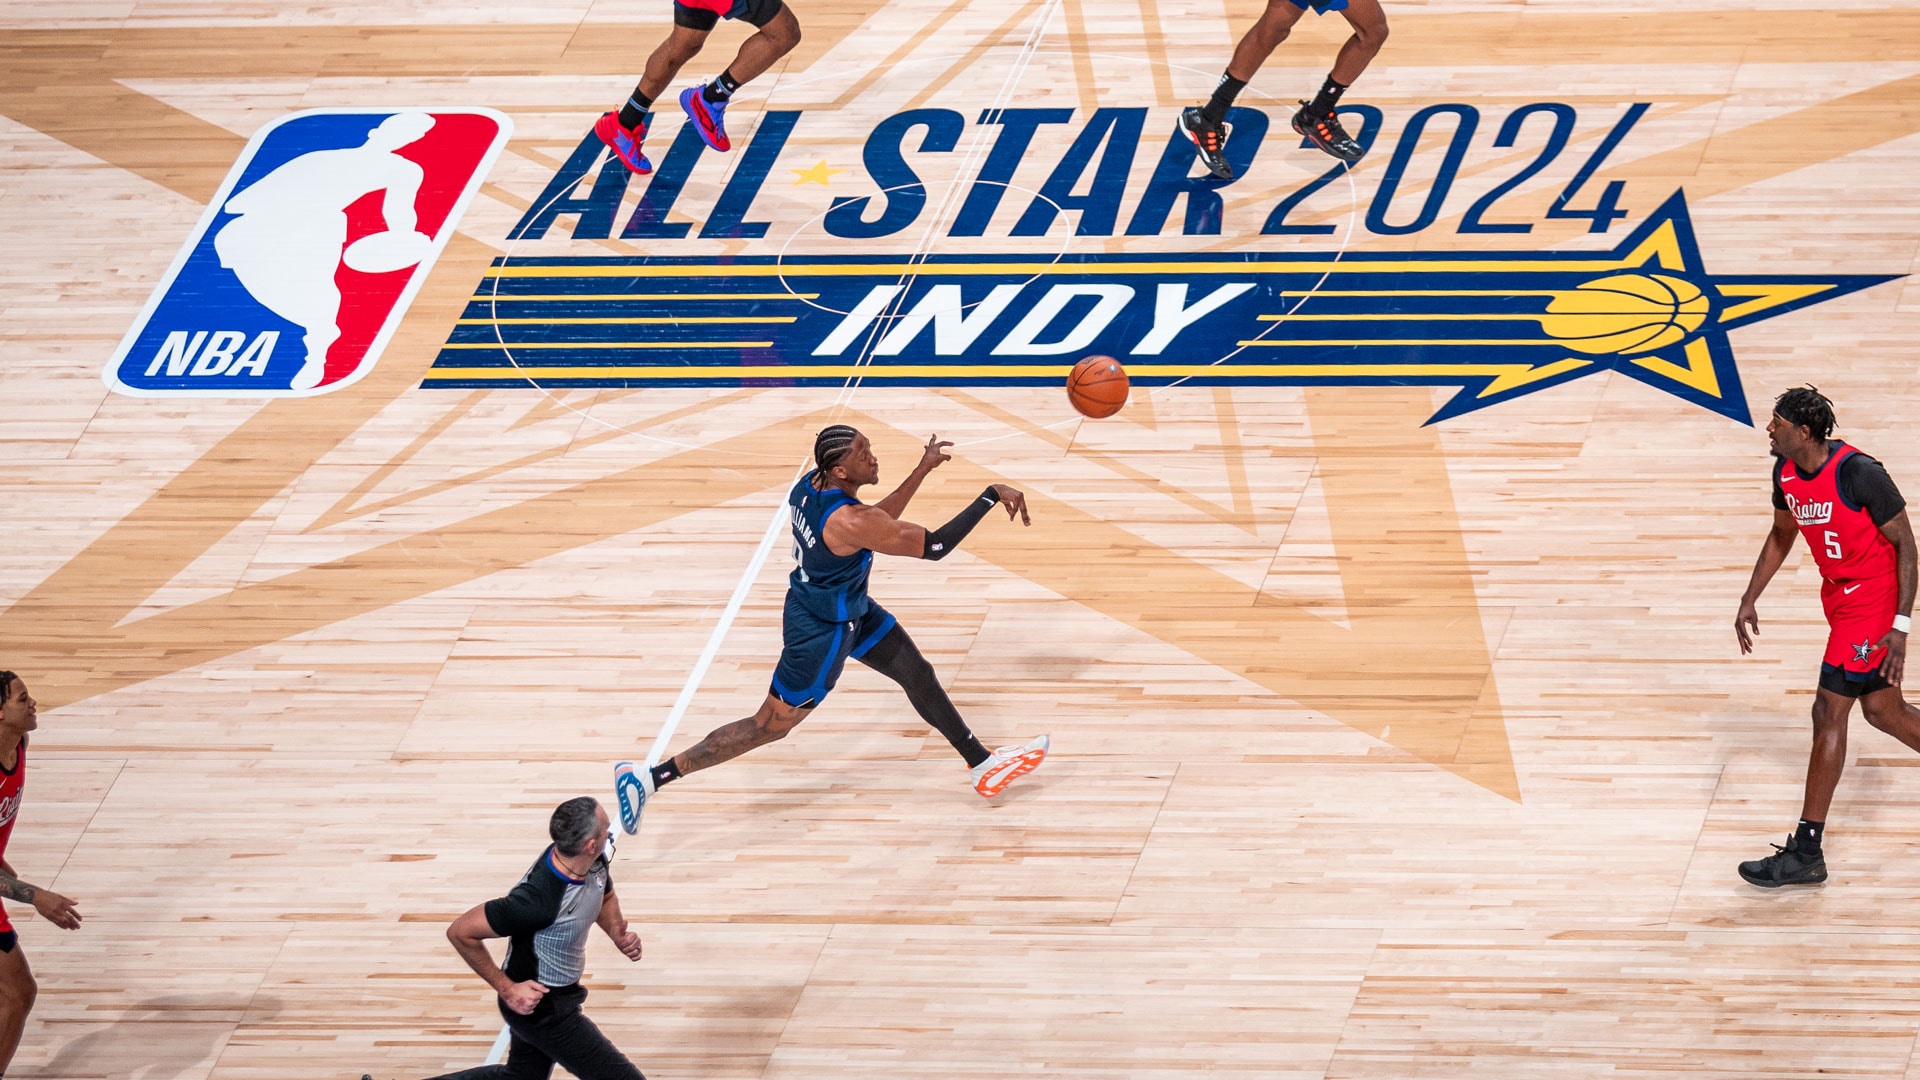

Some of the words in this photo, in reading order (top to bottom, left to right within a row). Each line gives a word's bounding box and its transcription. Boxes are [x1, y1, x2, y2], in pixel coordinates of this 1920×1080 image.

[506, 110, 803, 240] ALL
[823, 108, 1270, 239] STAR
[1260, 102, 1653, 235] 2024
[811, 282, 1258, 357] INDY
[144, 330, 281, 377] NBA
[1785, 493, 1833, 526] Rising
[1824, 530, 1843, 560] 5
